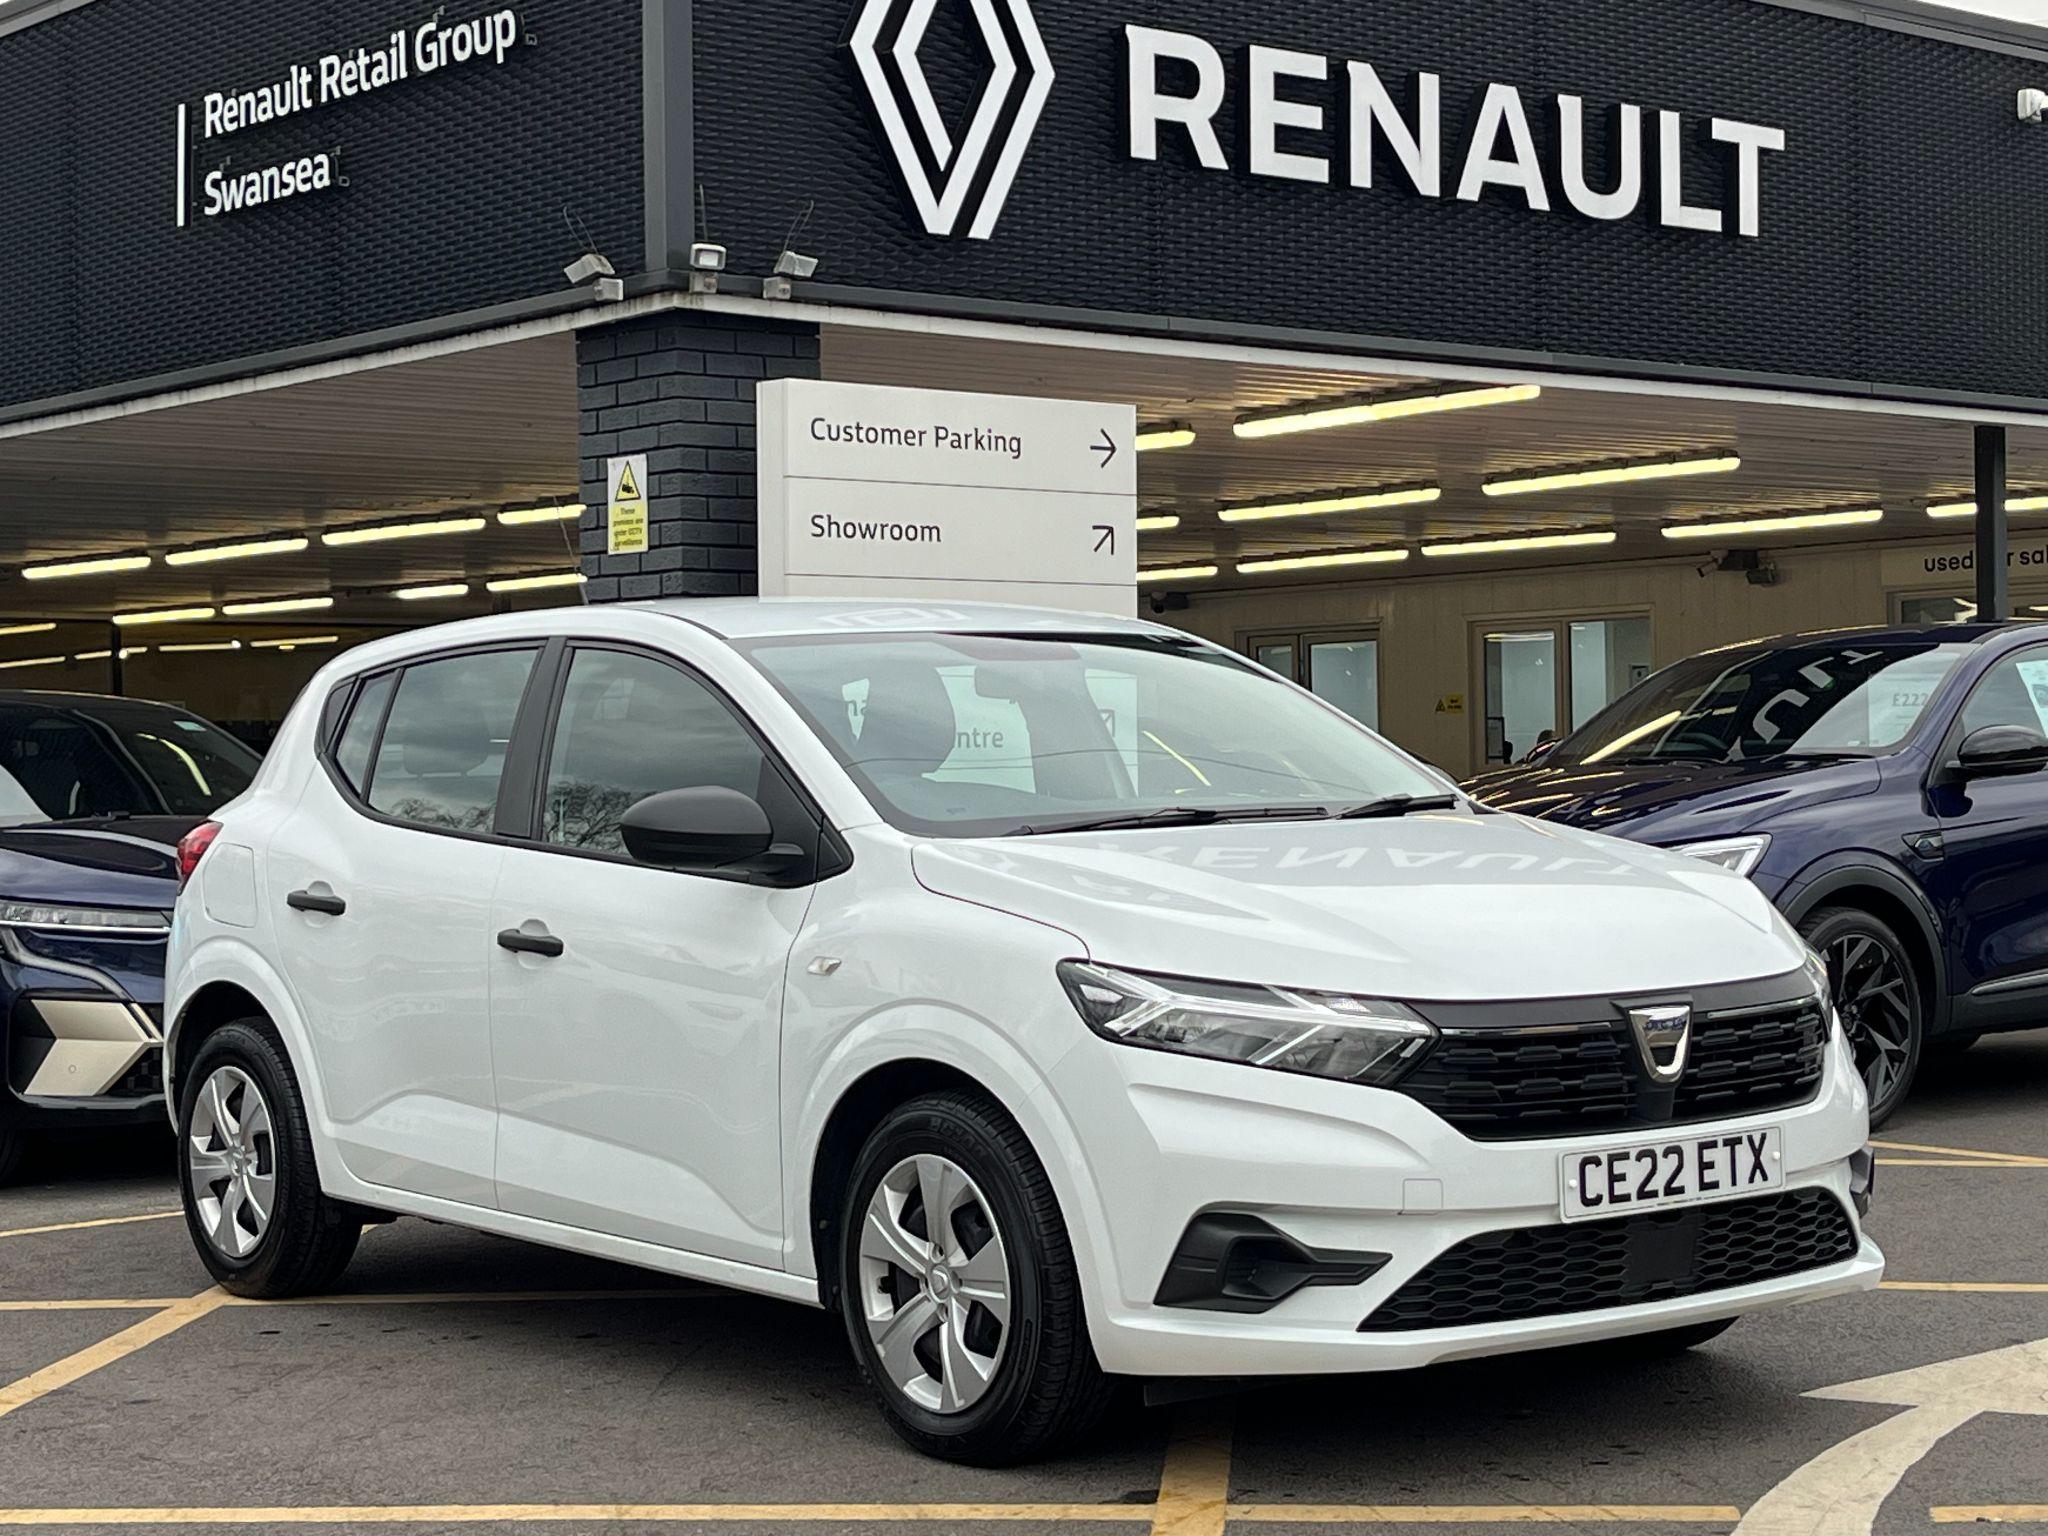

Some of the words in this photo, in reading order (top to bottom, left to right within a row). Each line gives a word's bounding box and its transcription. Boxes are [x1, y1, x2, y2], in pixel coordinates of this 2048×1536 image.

[204, 65, 313, 138] Renault
[319, 30, 408, 103] Retail
[415, 9, 516, 73] Group
[1125, 23, 1785, 237] RENAULT
[204, 153, 330, 216] Swansea
[810, 417, 927, 447] Customer
[934, 425, 1022, 459] Parking
[810, 514, 942, 542] Showroom
[1924, 550, 1974, 572] used
[957, 727, 1004, 748] ntre
[1578, 1144, 1686, 1207] CE22
[1697, 1132, 1769, 1192] ETX
